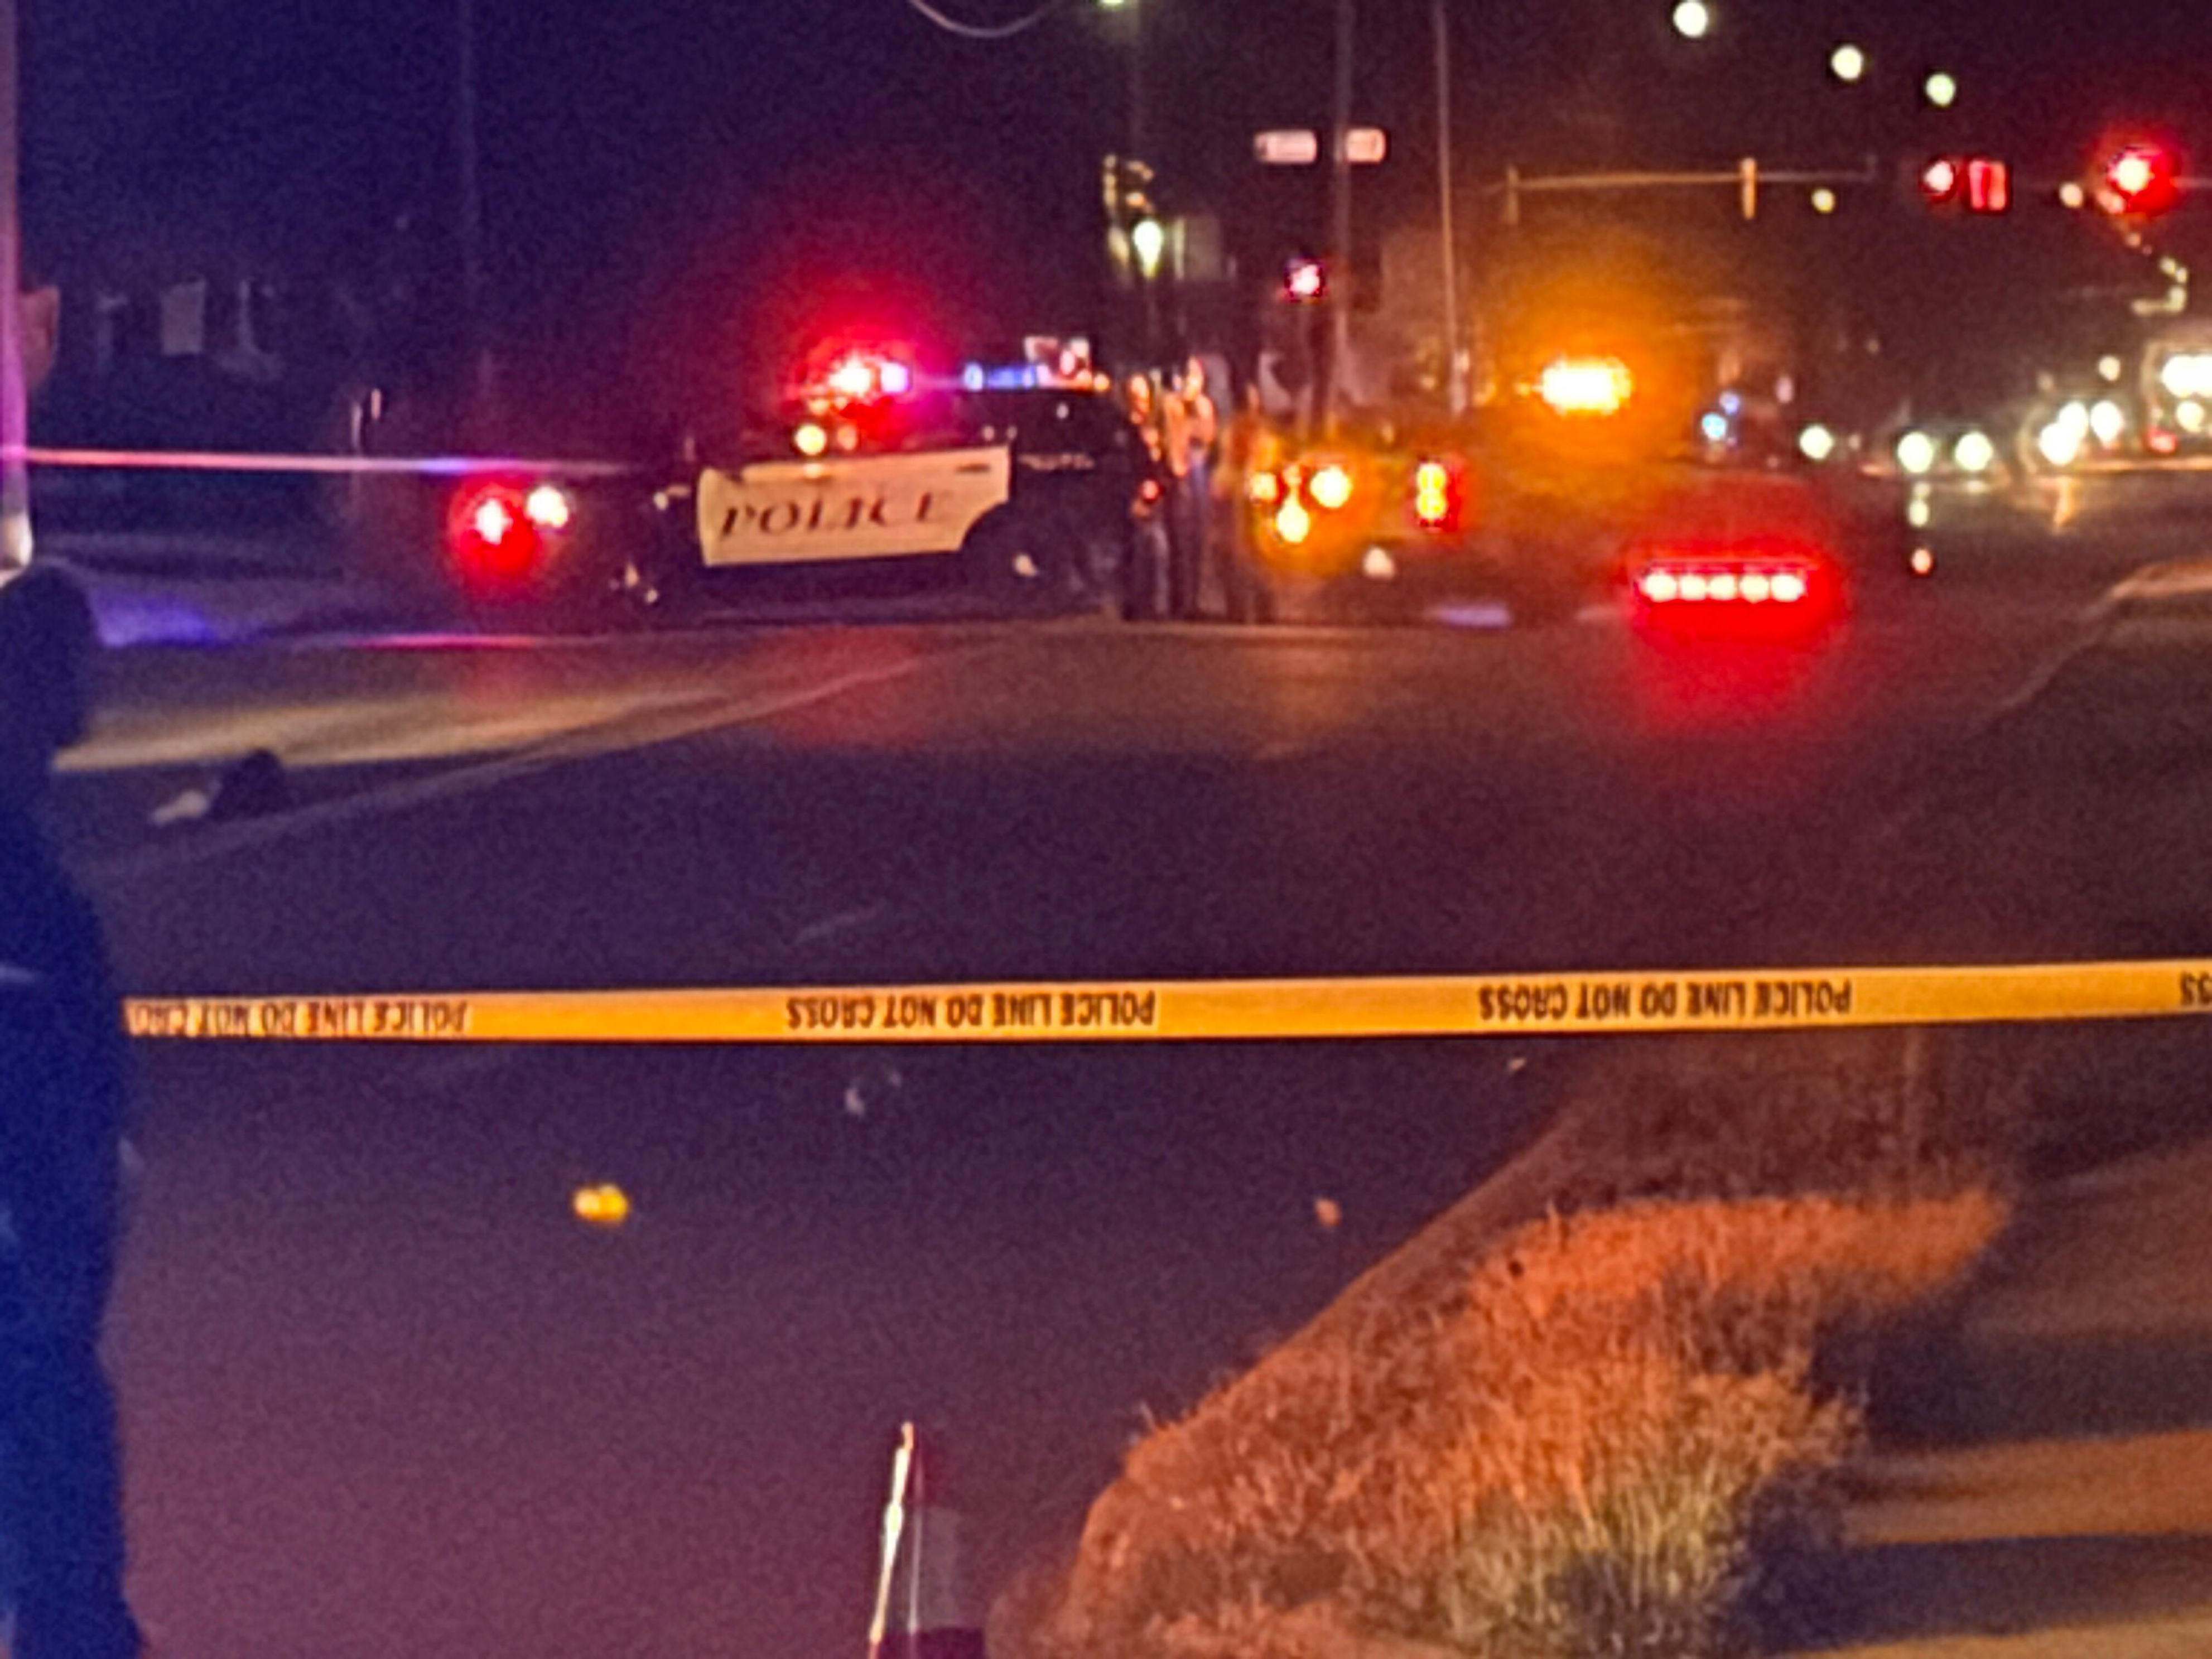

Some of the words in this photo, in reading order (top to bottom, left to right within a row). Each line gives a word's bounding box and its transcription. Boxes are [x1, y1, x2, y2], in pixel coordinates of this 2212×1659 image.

[721, 492, 946, 540] POLICE
[786, 996, 876, 1029] CROSS
[882, 995, 937, 1029] NOT
[946, 994, 983, 1028] DO
[992, 993, 1052, 1026] LINE
[1060, 991, 1156, 1026] POLICE
[1478, 984, 1568, 1020] CROSS
[1576, 982, 1631, 1019] NOT
[1640, 982, 1677, 1017] DO
[1687, 981, 1746, 1016] LINE
[1754, 979, 1852, 1015] POLICE
[201, 1004, 249, 1036] NOT
[262, 1004, 295, 1036] DO
[307, 1002, 364, 1035] LINE
[374, 1001, 468, 1034] POLICE
